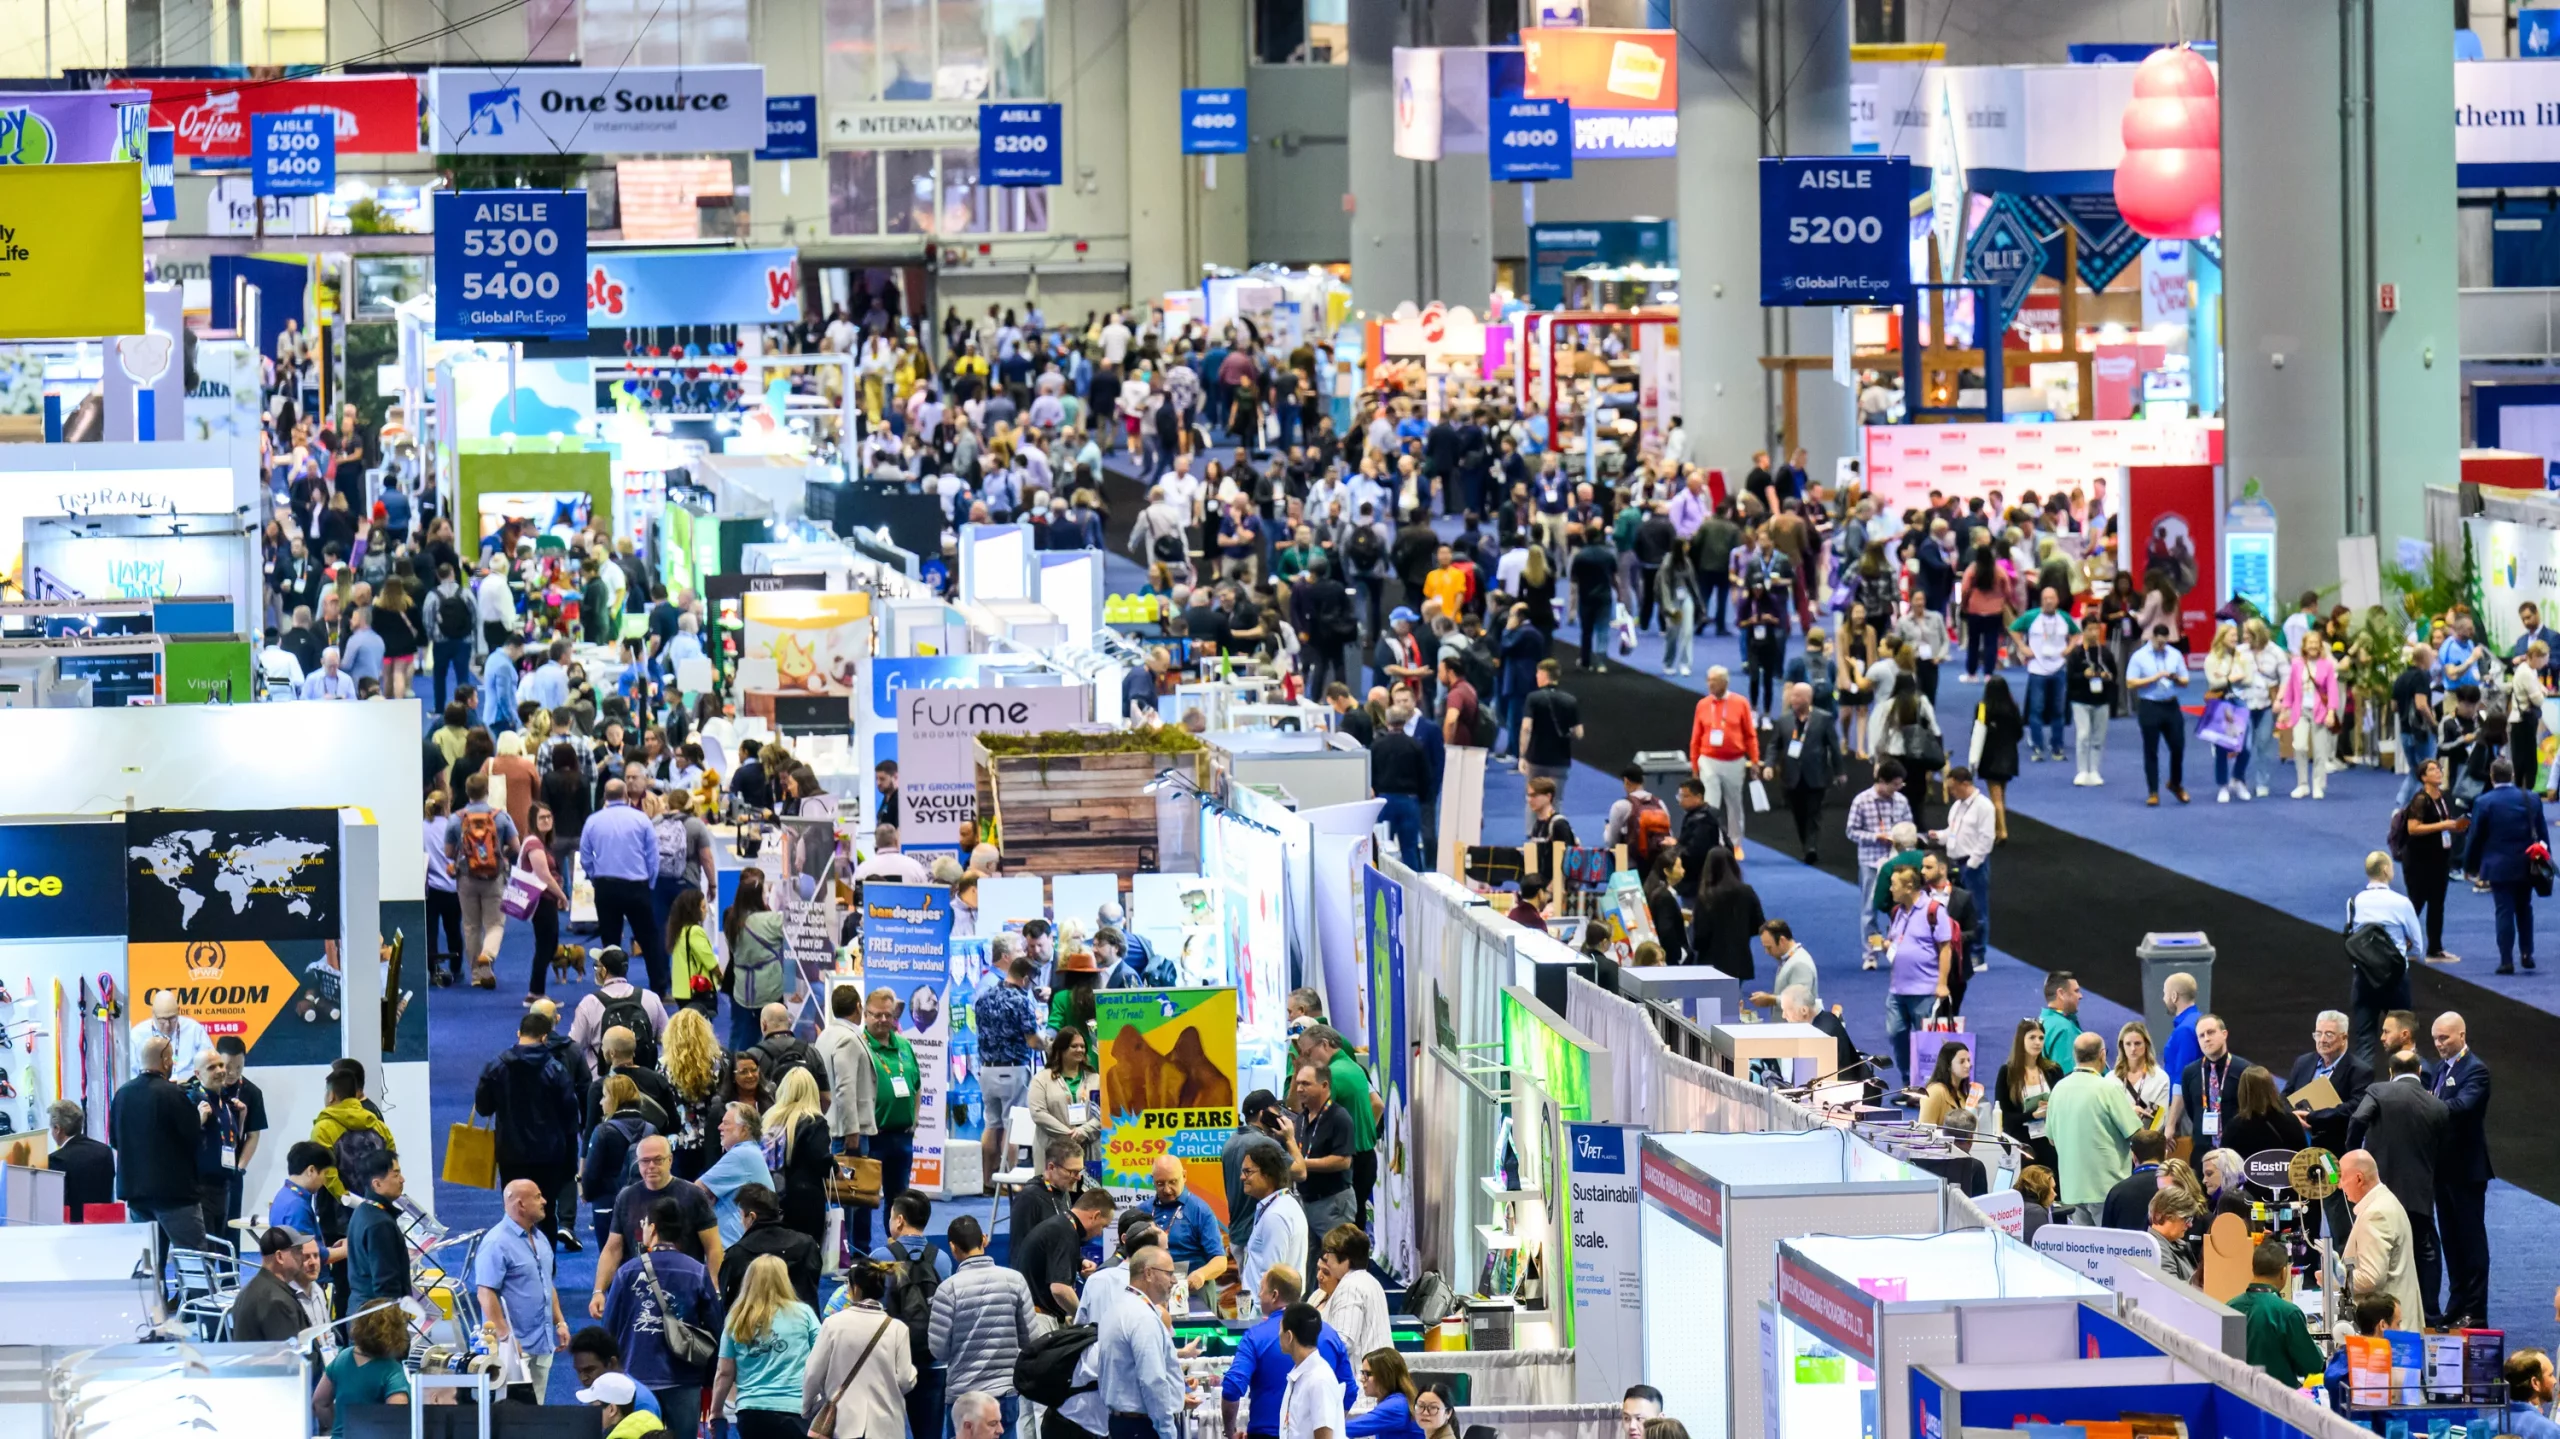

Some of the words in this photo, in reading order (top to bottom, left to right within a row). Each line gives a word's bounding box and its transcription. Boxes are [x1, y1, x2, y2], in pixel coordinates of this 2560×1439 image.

[540, 89, 607, 113] One
[615, 89, 730, 113] Source
[1197, 93, 1231, 104] AISLE
[1000, 110, 1041, 122] AISLE
[1509, 104, 1551, 117] AISLE
[2455, 104, 2526, 126] them
[178, 105, 242, 152] Orijen
[273, 120, 313, 133] AISLE
[593, 120, 677, 132] International
[267, 134, 320, 151] 5300
[994, 136, 1048, 152] 5200
[1503, 129, 1558, 147] 4900
[267, 157, 321, 175] 5400
[1799, 170, 1872, 188] AISLE
[474, 203, 547, 222] AISLE
[1788, 216, 1882, 244] 5200
[463, 228, 559, 256] 5300
[1983, 251, 2023, 269] BLUE
[463, 272, 560, 300] 5400
[1795, 276, 1838, 290] Global
[1839, 276, 1858, 289] Pet
[1859, 276, 1889, 291] Expo
[471, 310, 513, 325] Global
[515, 311, 534, 324] Pet
[536, 311, 566, 327] Expo
[108, 560, 165, 584] HAPPY
[187, 678, 228, 689] Vision
[912, 697, 1029, 726] furme
[907, 784, 925, 792] PET
[869, 894, 941, 924] bandoggies
[868, 937, 893, 953] FREE
[895, 942, 944, 955] personalized
[144, 985, 270, 1007] OM/ODM
[1096, 994, 1123, 1005] Great
[1125, 993, 1153, 1004] Lakes
[194, 1007, 202, 1015] IN
[205, 1007, 246, 1015] CAMBODIA
[1144, 1112, 1179, 1130] PIG
[1184, 1110, 1232, 1128] EARS
[1110, 1139, 1167, 1155] $0.59
[1572, 1182, 1638, 1204] Sustainabili
[1574, 1208, 1584, 1224] at
[1997, 1205, 2022, 1221] bioactive
[2010, 1221, 2022, 1235] pets
[1574, 1231, 1608, 1249] scale.
[2034, 1240, 2064, 1251] Natural
[2066, 1242, 2105, 1254] bioactive
[2106, 1244, 2152, 1257] ingredients
[2087, 1258, 2099, 1269] for
